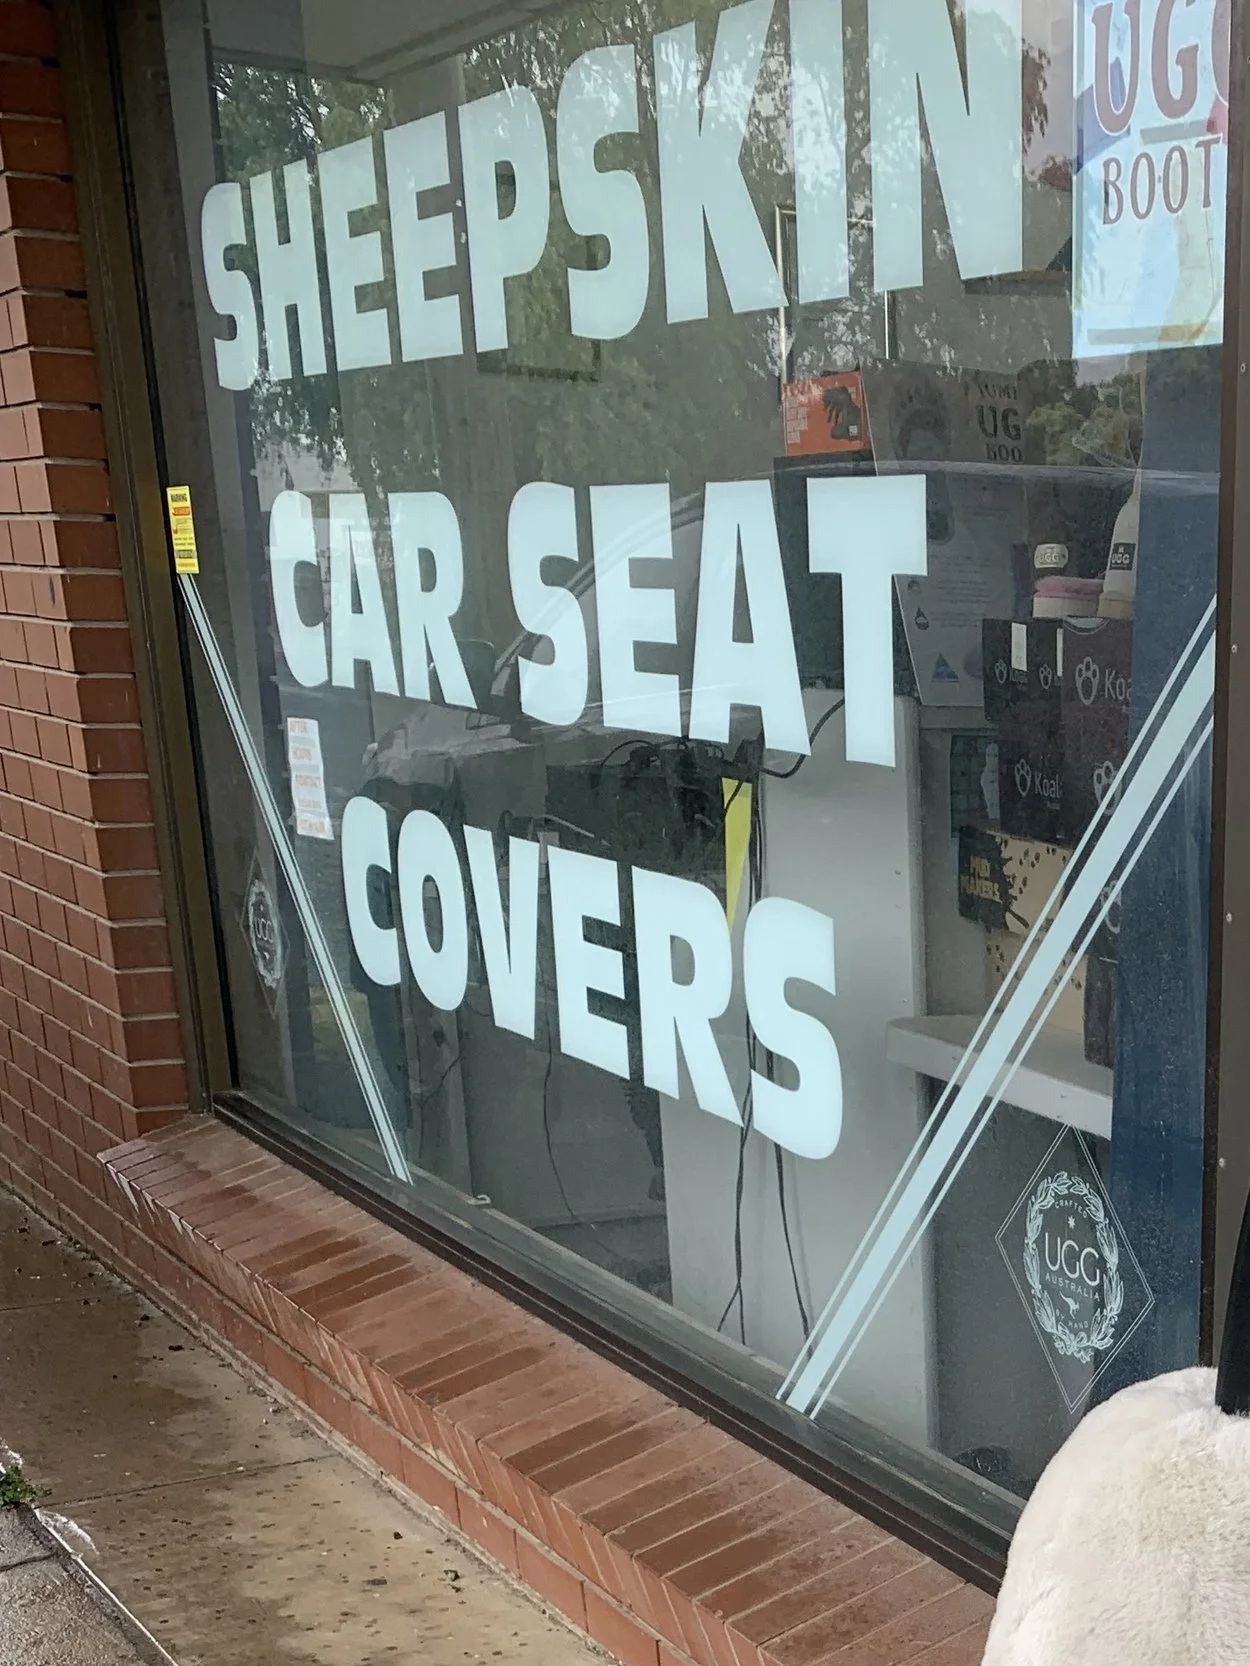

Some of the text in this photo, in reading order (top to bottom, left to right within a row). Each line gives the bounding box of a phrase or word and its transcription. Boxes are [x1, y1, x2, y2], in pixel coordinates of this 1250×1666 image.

[1091, 0, 1230, 134] UG
[202, 0, 1022, 391] SHEEPSKIN
[1103, 133, 1222, 224] BOOT
[269, 474, 927, 767] CAR SEAT
[342, 796, 843, 1160] COVERS
[1054, 1201, 1088, 1219] CRAFTED
[1045, 1274, 1100, 1301] AUSTRALIA
